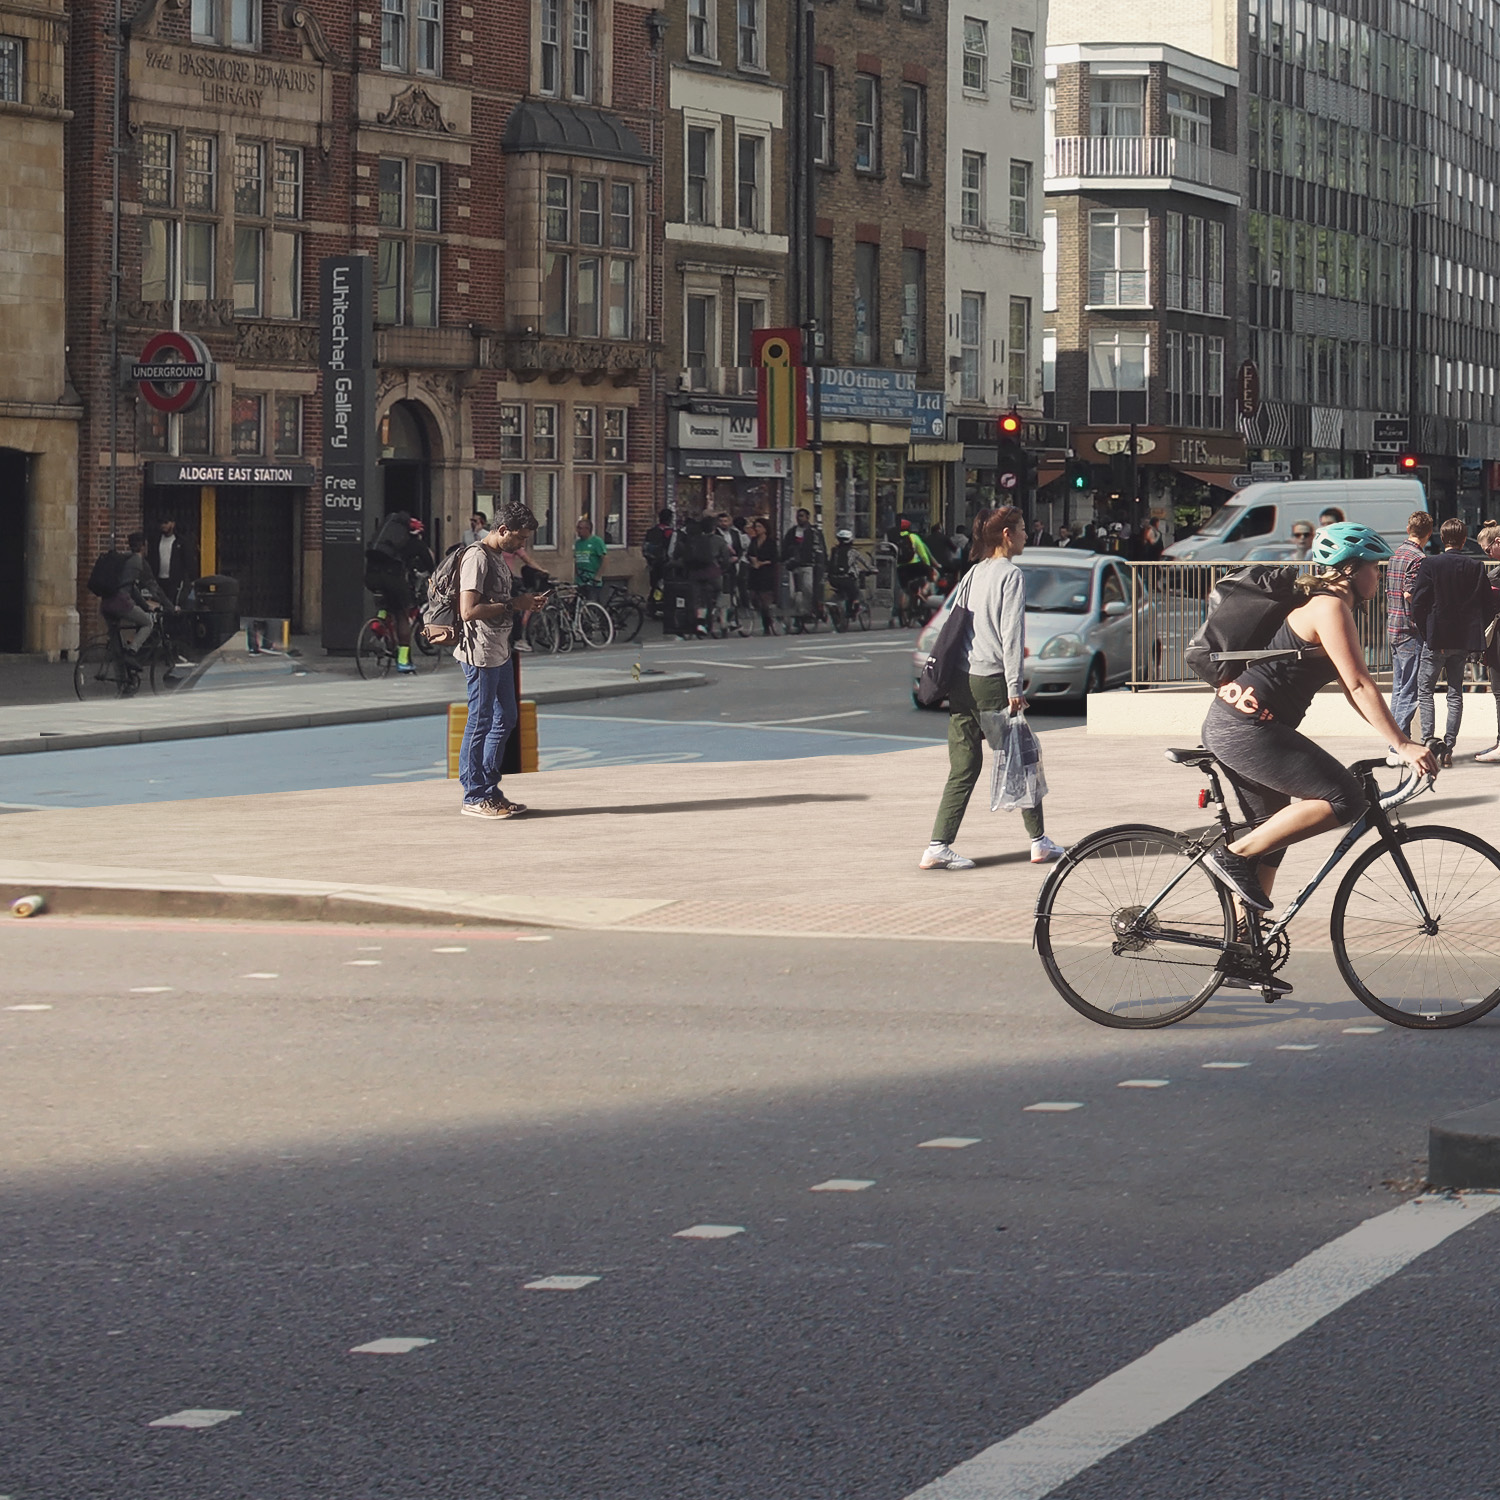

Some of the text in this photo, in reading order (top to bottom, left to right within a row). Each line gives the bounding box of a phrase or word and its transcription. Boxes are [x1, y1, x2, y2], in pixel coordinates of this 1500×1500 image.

[146, 47, 316, 93] THE PASSMORE EDWARDS
[202, 81, 263, 108] LIBRARY
[133, 366, 204, 378] UNDERGROUND
[1243, 365, 1253, 413] EFES
[917, 393, 941, 410] Ltd
[331, 377, 352, 448] Gallery
[729, 417, 753, 433] KVJ
[179, 467, 293, 481] ALDGATE EAST STATION
[325, 475, 357, 490] Free
[325, 494, 362, 511] Entry
